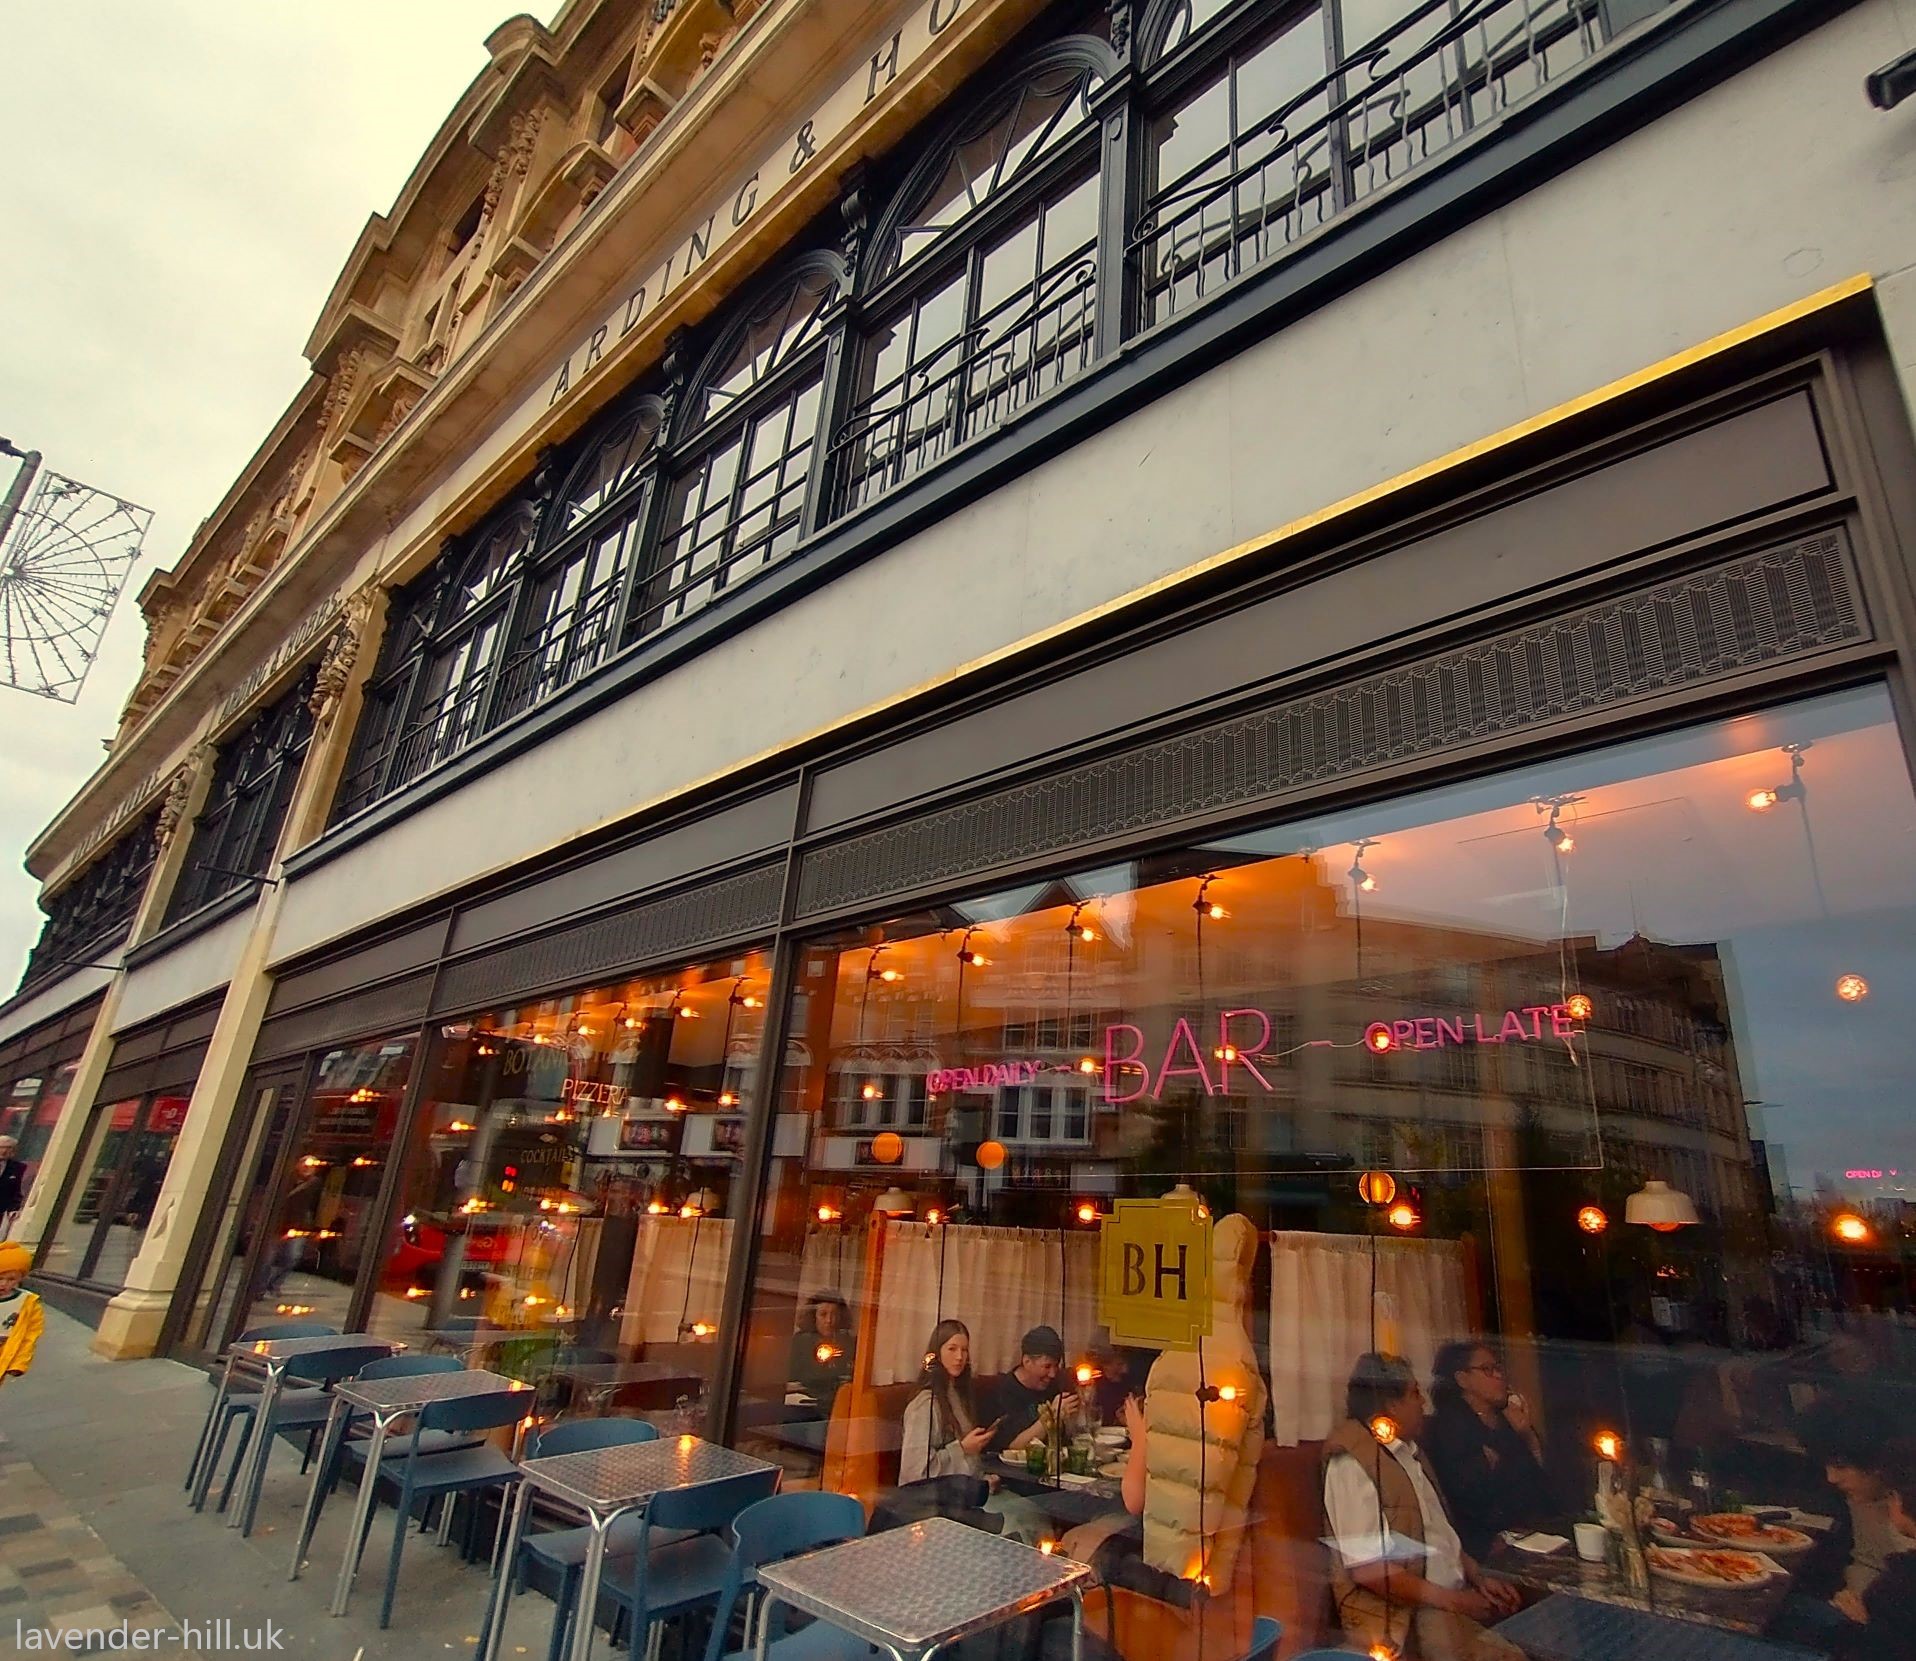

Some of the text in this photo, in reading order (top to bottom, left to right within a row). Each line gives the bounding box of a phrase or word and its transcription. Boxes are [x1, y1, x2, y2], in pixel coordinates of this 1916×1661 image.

[548, 172, 760, 407] ARDING
[788, 120, 817, 175] &
[1102, 1009, 1274, 1102] BAR
[1364, 1004, 1576, 1054] OPEN LATE
[560, 1078, 629, 1105] PIZZERIA
[926, 1060, 1041, 1093] OPEN DAILY
[1122, 1241, 1187, 1300] BH
